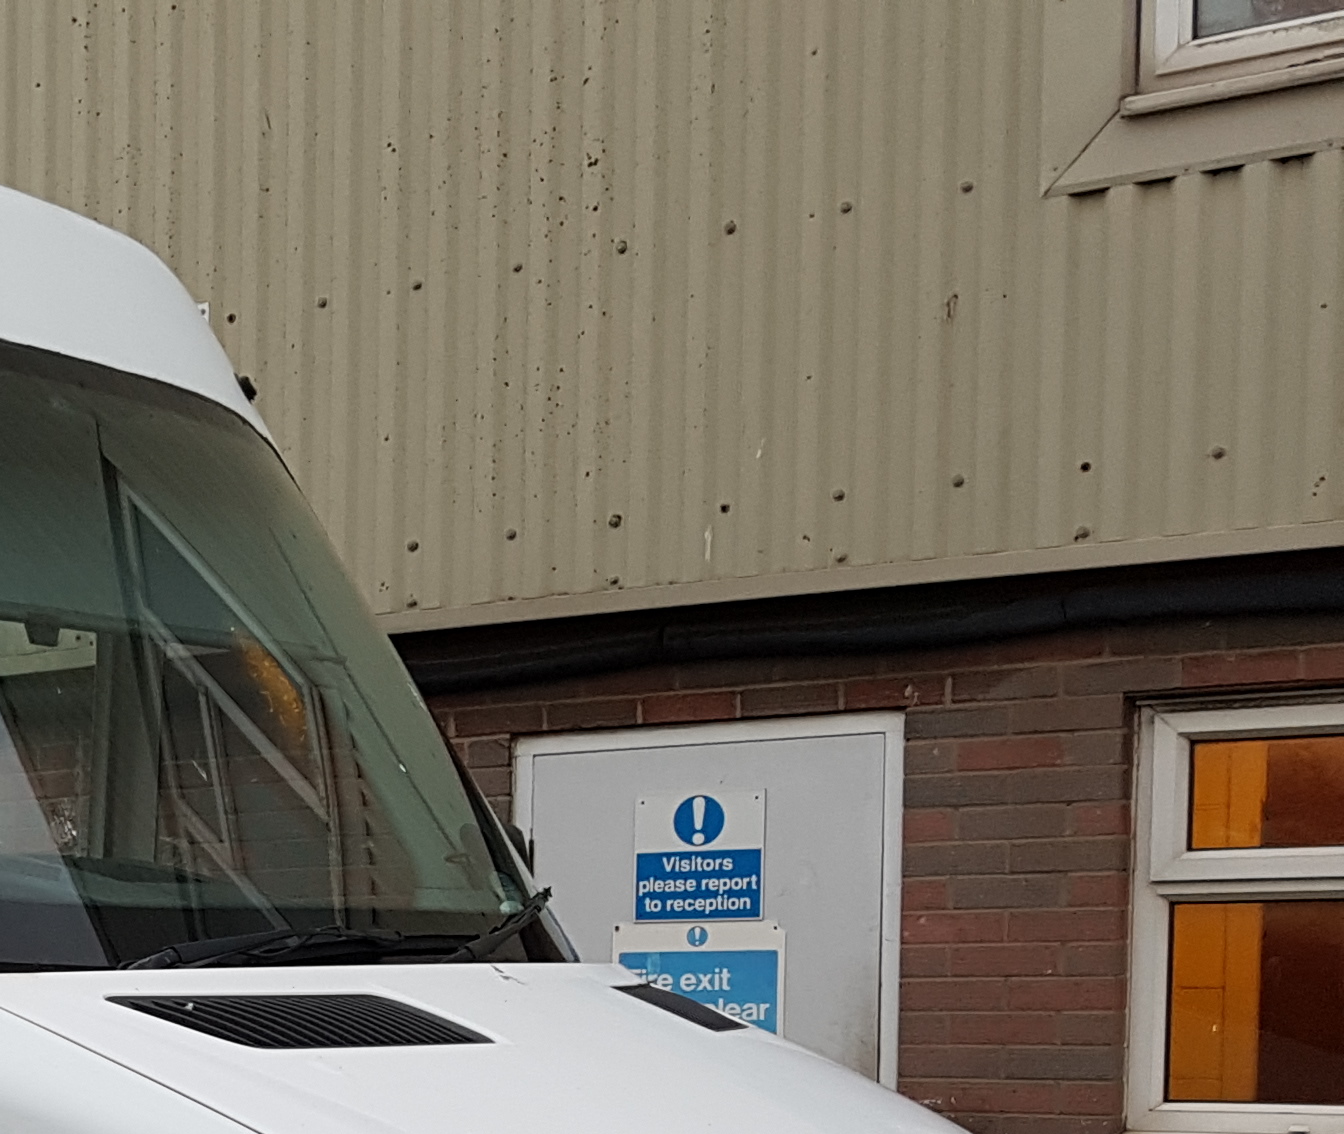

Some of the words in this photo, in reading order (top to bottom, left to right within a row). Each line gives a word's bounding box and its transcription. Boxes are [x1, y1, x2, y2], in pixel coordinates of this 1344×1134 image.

[662, 855, 733, 872] Visitors
[638, 877, 697, 896] please
[701, 874, 758, 894] report
[644, 897, 662, 912] to
[666, 894, 751, 914] reception
[680, 968, 731, 992] exit
